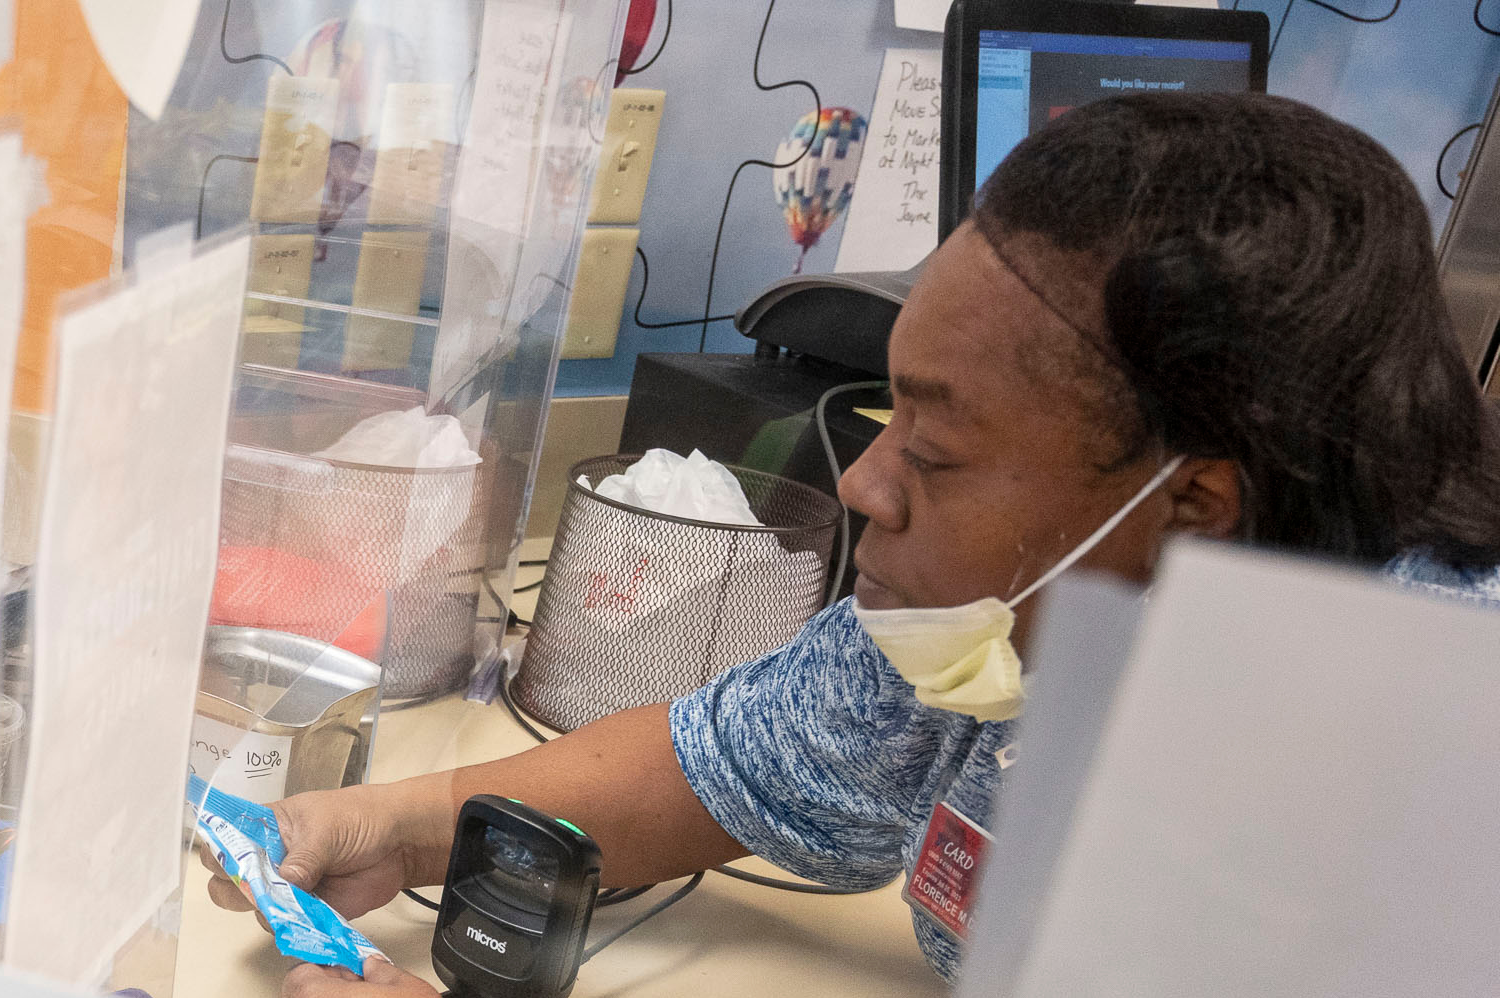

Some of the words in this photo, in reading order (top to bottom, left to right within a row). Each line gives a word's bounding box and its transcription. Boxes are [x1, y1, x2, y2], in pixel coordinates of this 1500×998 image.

[898, 61, 942, 92] Pleas
[1099, 77, 1120, 89] Would
[1121, 80, 1133, 91] you
[1134, 78, 1146, 89] like
[1146, 81, 1160, 91] your
[1161, 80, 1185, 91] receipt?
[884, 126, 897, 147] to
[878, 149, 895, 169] at
[899, 151, 935, 175] Night
[192, 740, 232, 761] nge
[247, 750, 282, 767] 100%
[943, 842, 974, 870] CARD
[913, 874, 959, 917] FLORENCE
[466, 926, 507, 954] micros
